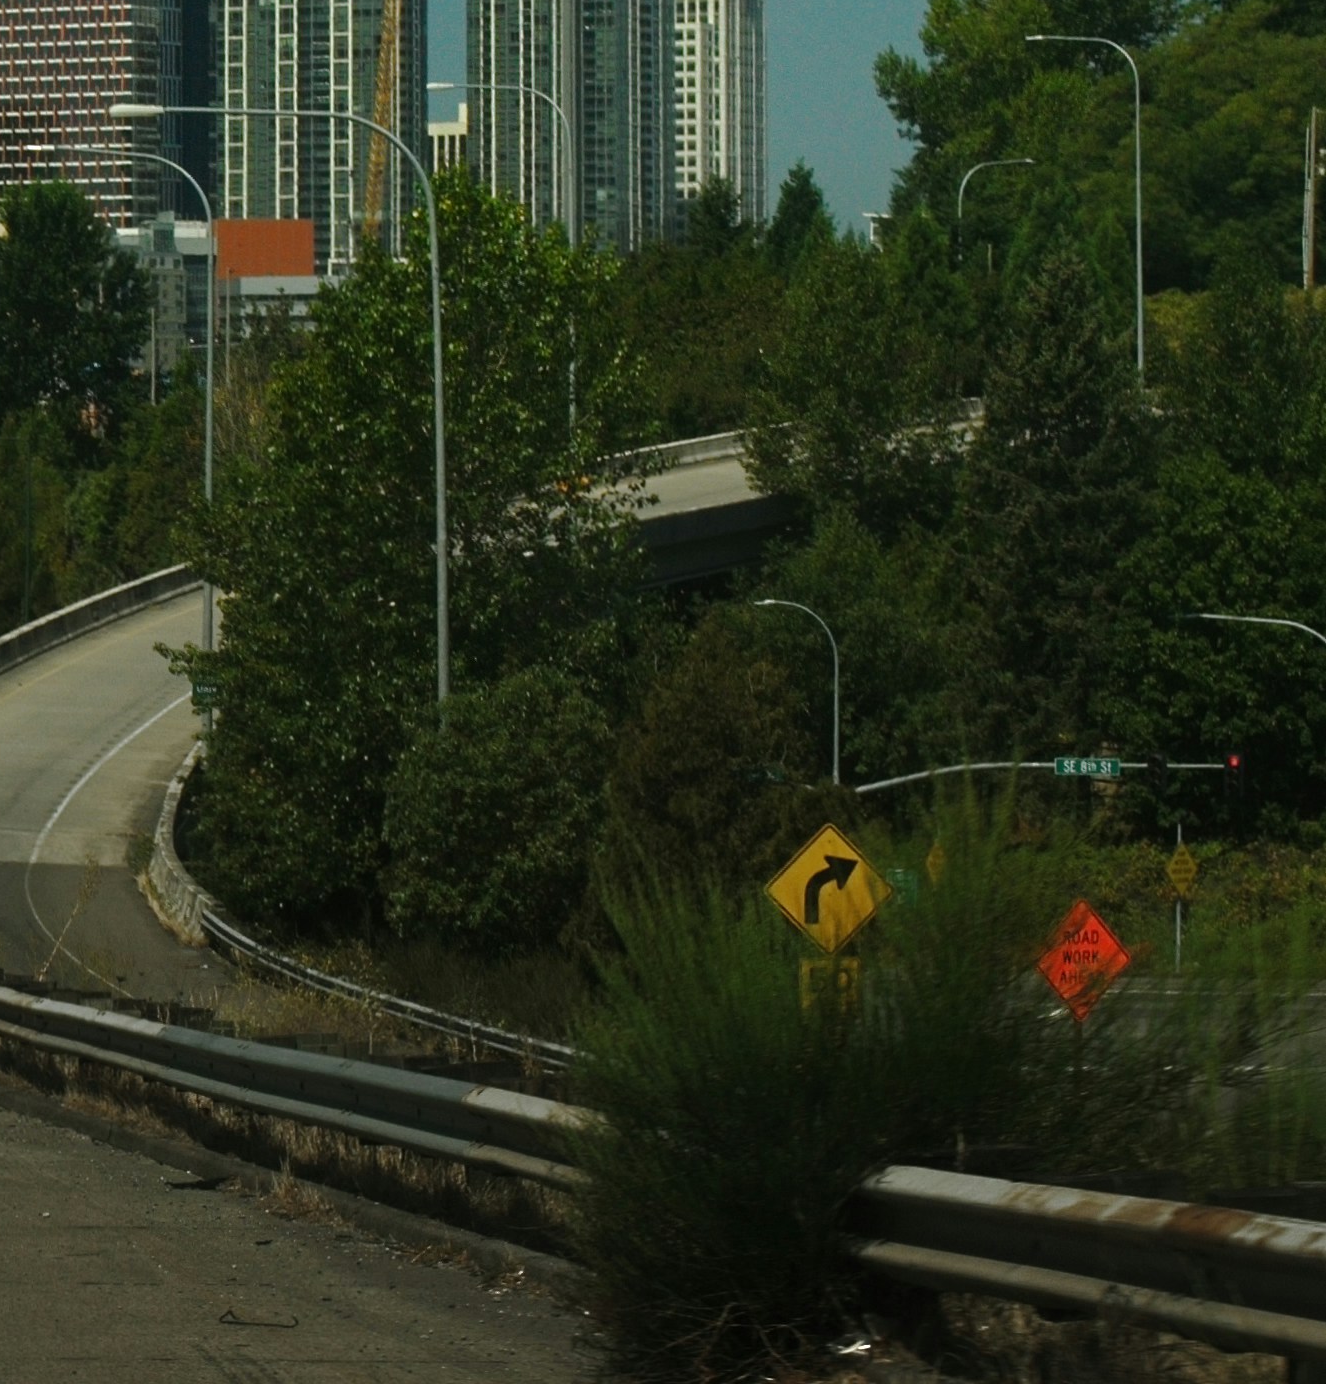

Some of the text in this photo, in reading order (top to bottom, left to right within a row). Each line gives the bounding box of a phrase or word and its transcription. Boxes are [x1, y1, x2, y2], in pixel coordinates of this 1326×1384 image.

[1063, 760, 1111, 773] SE 8th St
[1063, 930, 1099, 944] ROAD
[1063, 950, 1099, 964] WORK
